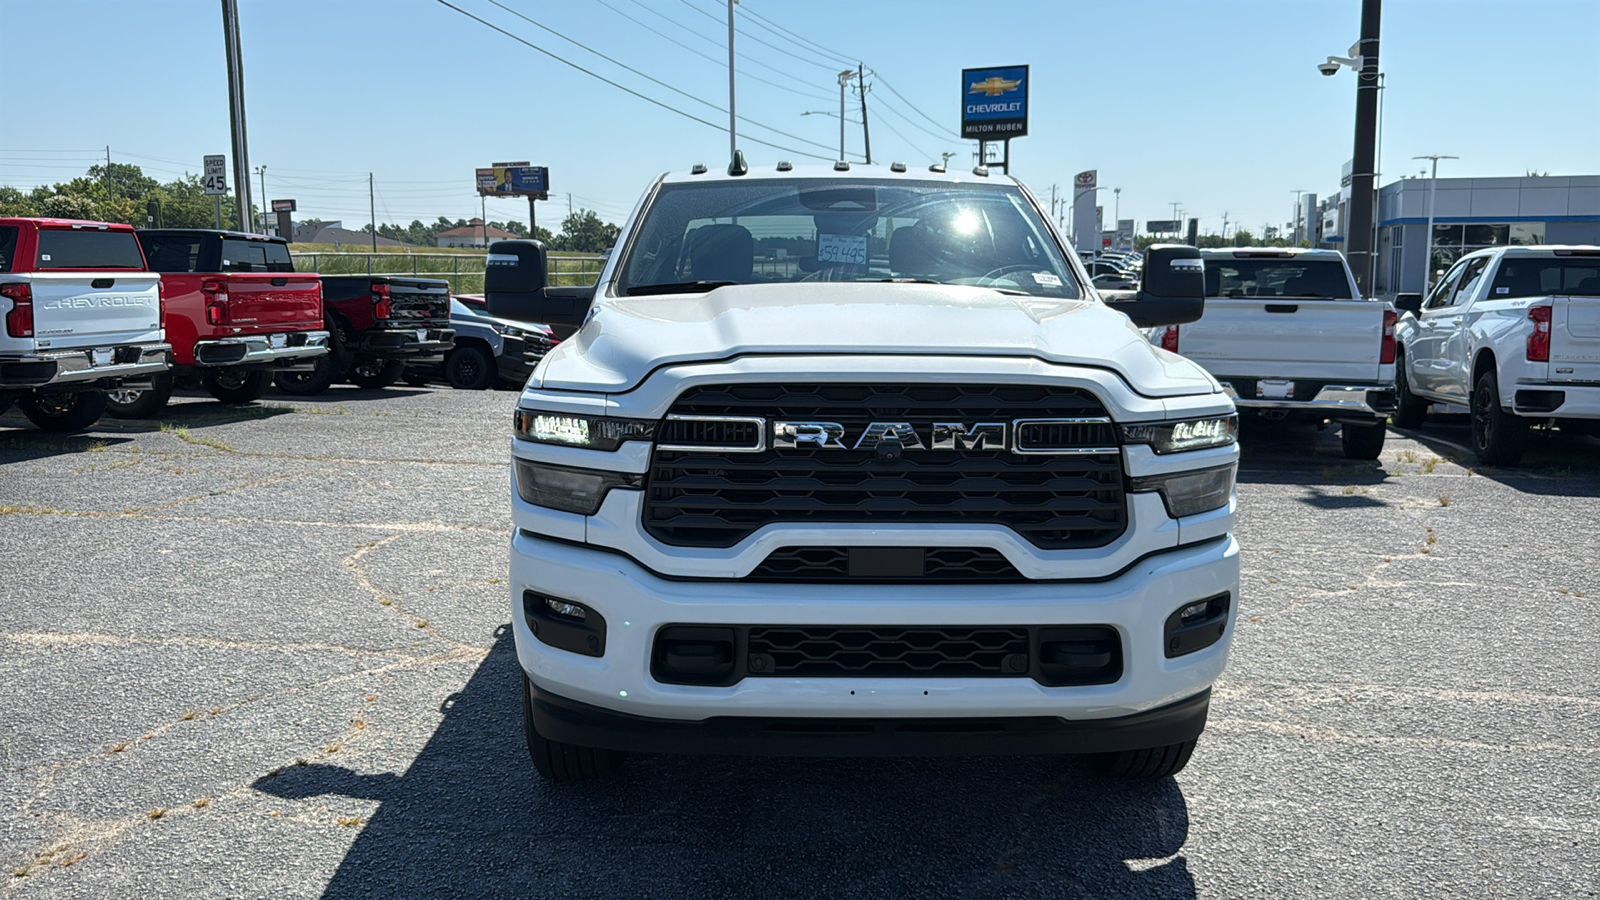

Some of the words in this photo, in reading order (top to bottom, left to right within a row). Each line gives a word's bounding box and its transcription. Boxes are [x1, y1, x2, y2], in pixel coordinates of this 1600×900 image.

[966, 102, 1021, 114] CHEVROLET
[965, 124, 993, 133] MILTON
[995, 122, 1023, 132] RUBEN
[205, 159, 224, 167] SPEED
[207, 167, 222, 175] LIMIT
[206, 176, 225, 191] 45
[43, 295, 153, 310] CHEVROLET
[773, 421, 1006, 450] RAM
